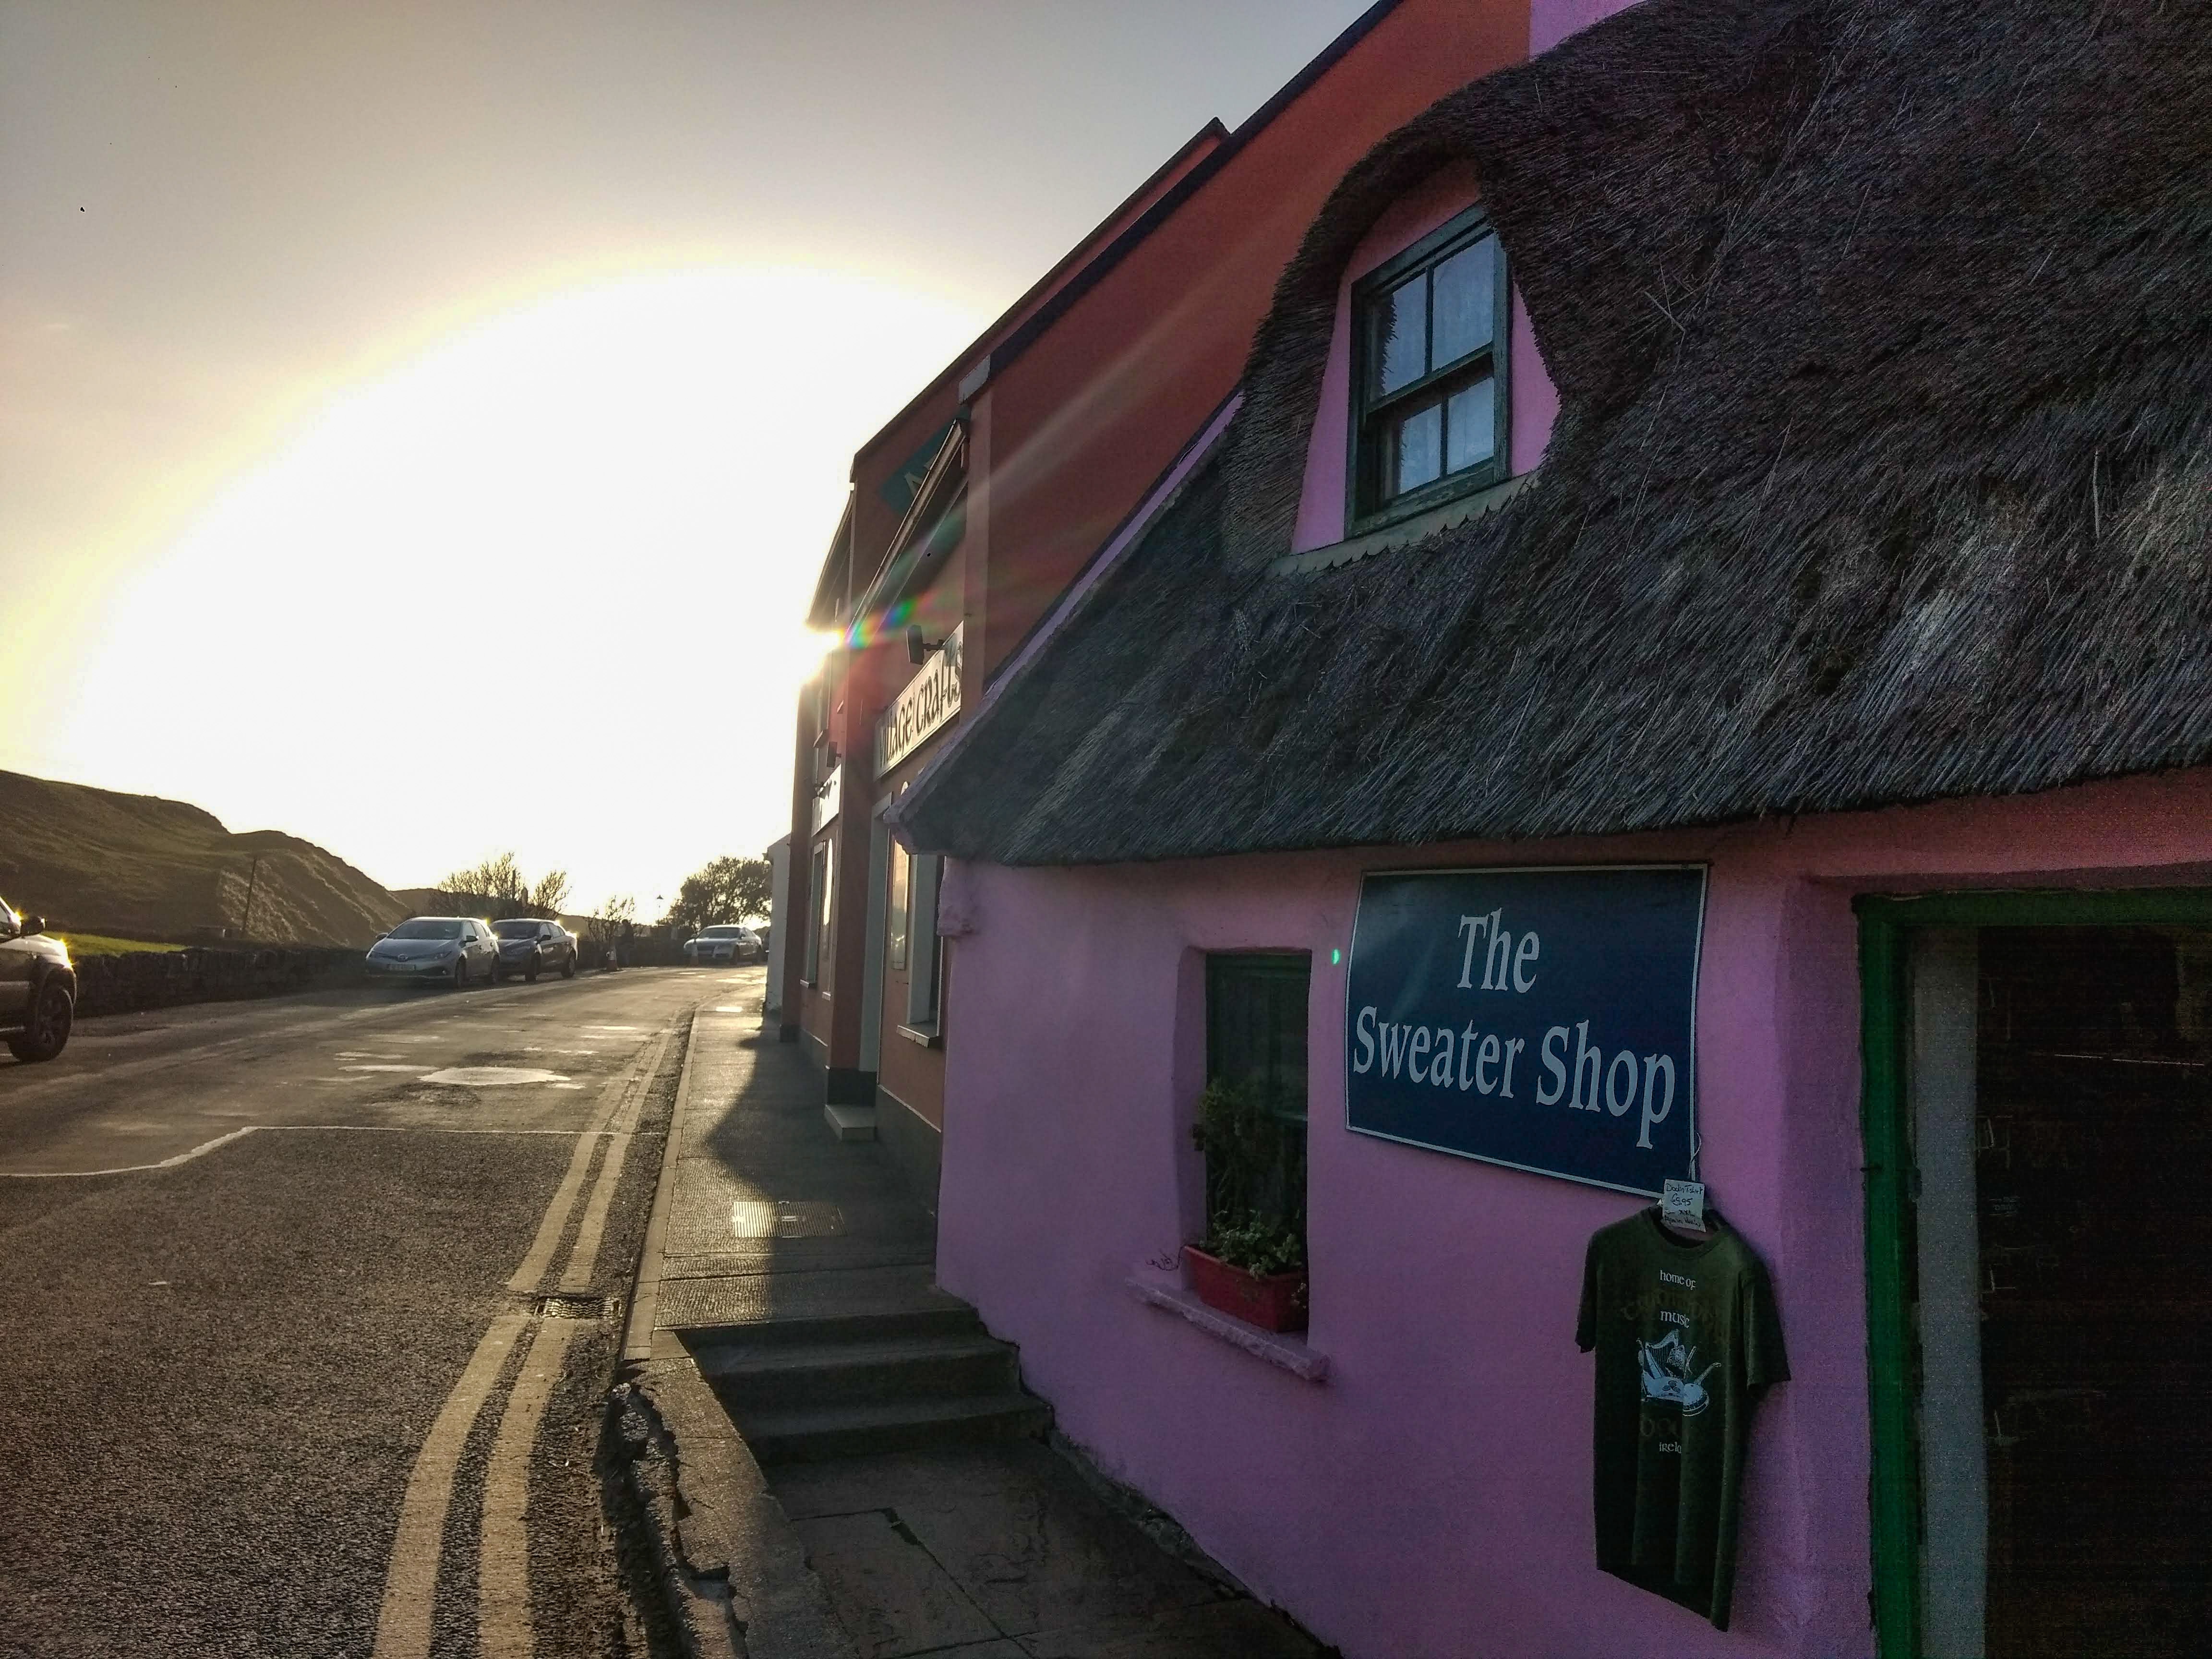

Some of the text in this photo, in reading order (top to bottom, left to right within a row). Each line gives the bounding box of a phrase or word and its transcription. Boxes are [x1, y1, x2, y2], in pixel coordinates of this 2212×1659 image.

[1457, 907, 1540, 993] The
[1353, 1006, 1675, 1149] Sweater Shop
[1660, 1270, 1696, 1290] home of
[1660, 1310, 1690, 1328] music
